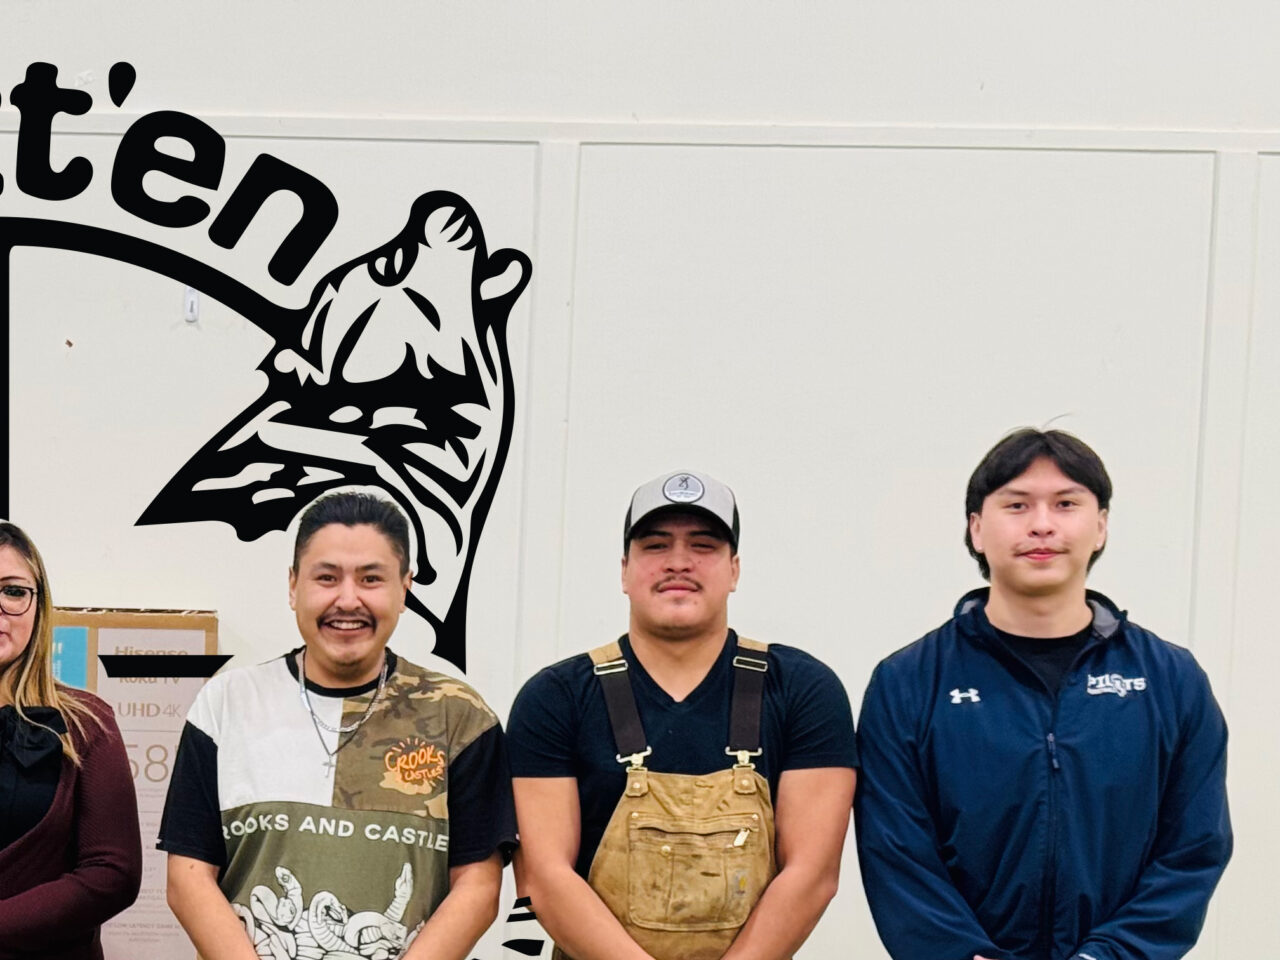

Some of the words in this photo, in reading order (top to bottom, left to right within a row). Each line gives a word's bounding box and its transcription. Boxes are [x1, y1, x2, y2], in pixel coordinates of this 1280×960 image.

[118, 702, 161, 718] UHD
[162, 703, 182, 718] 4K
[384, 744, 446, 774] CROOKS
[298, 816, 355, 838] AND
